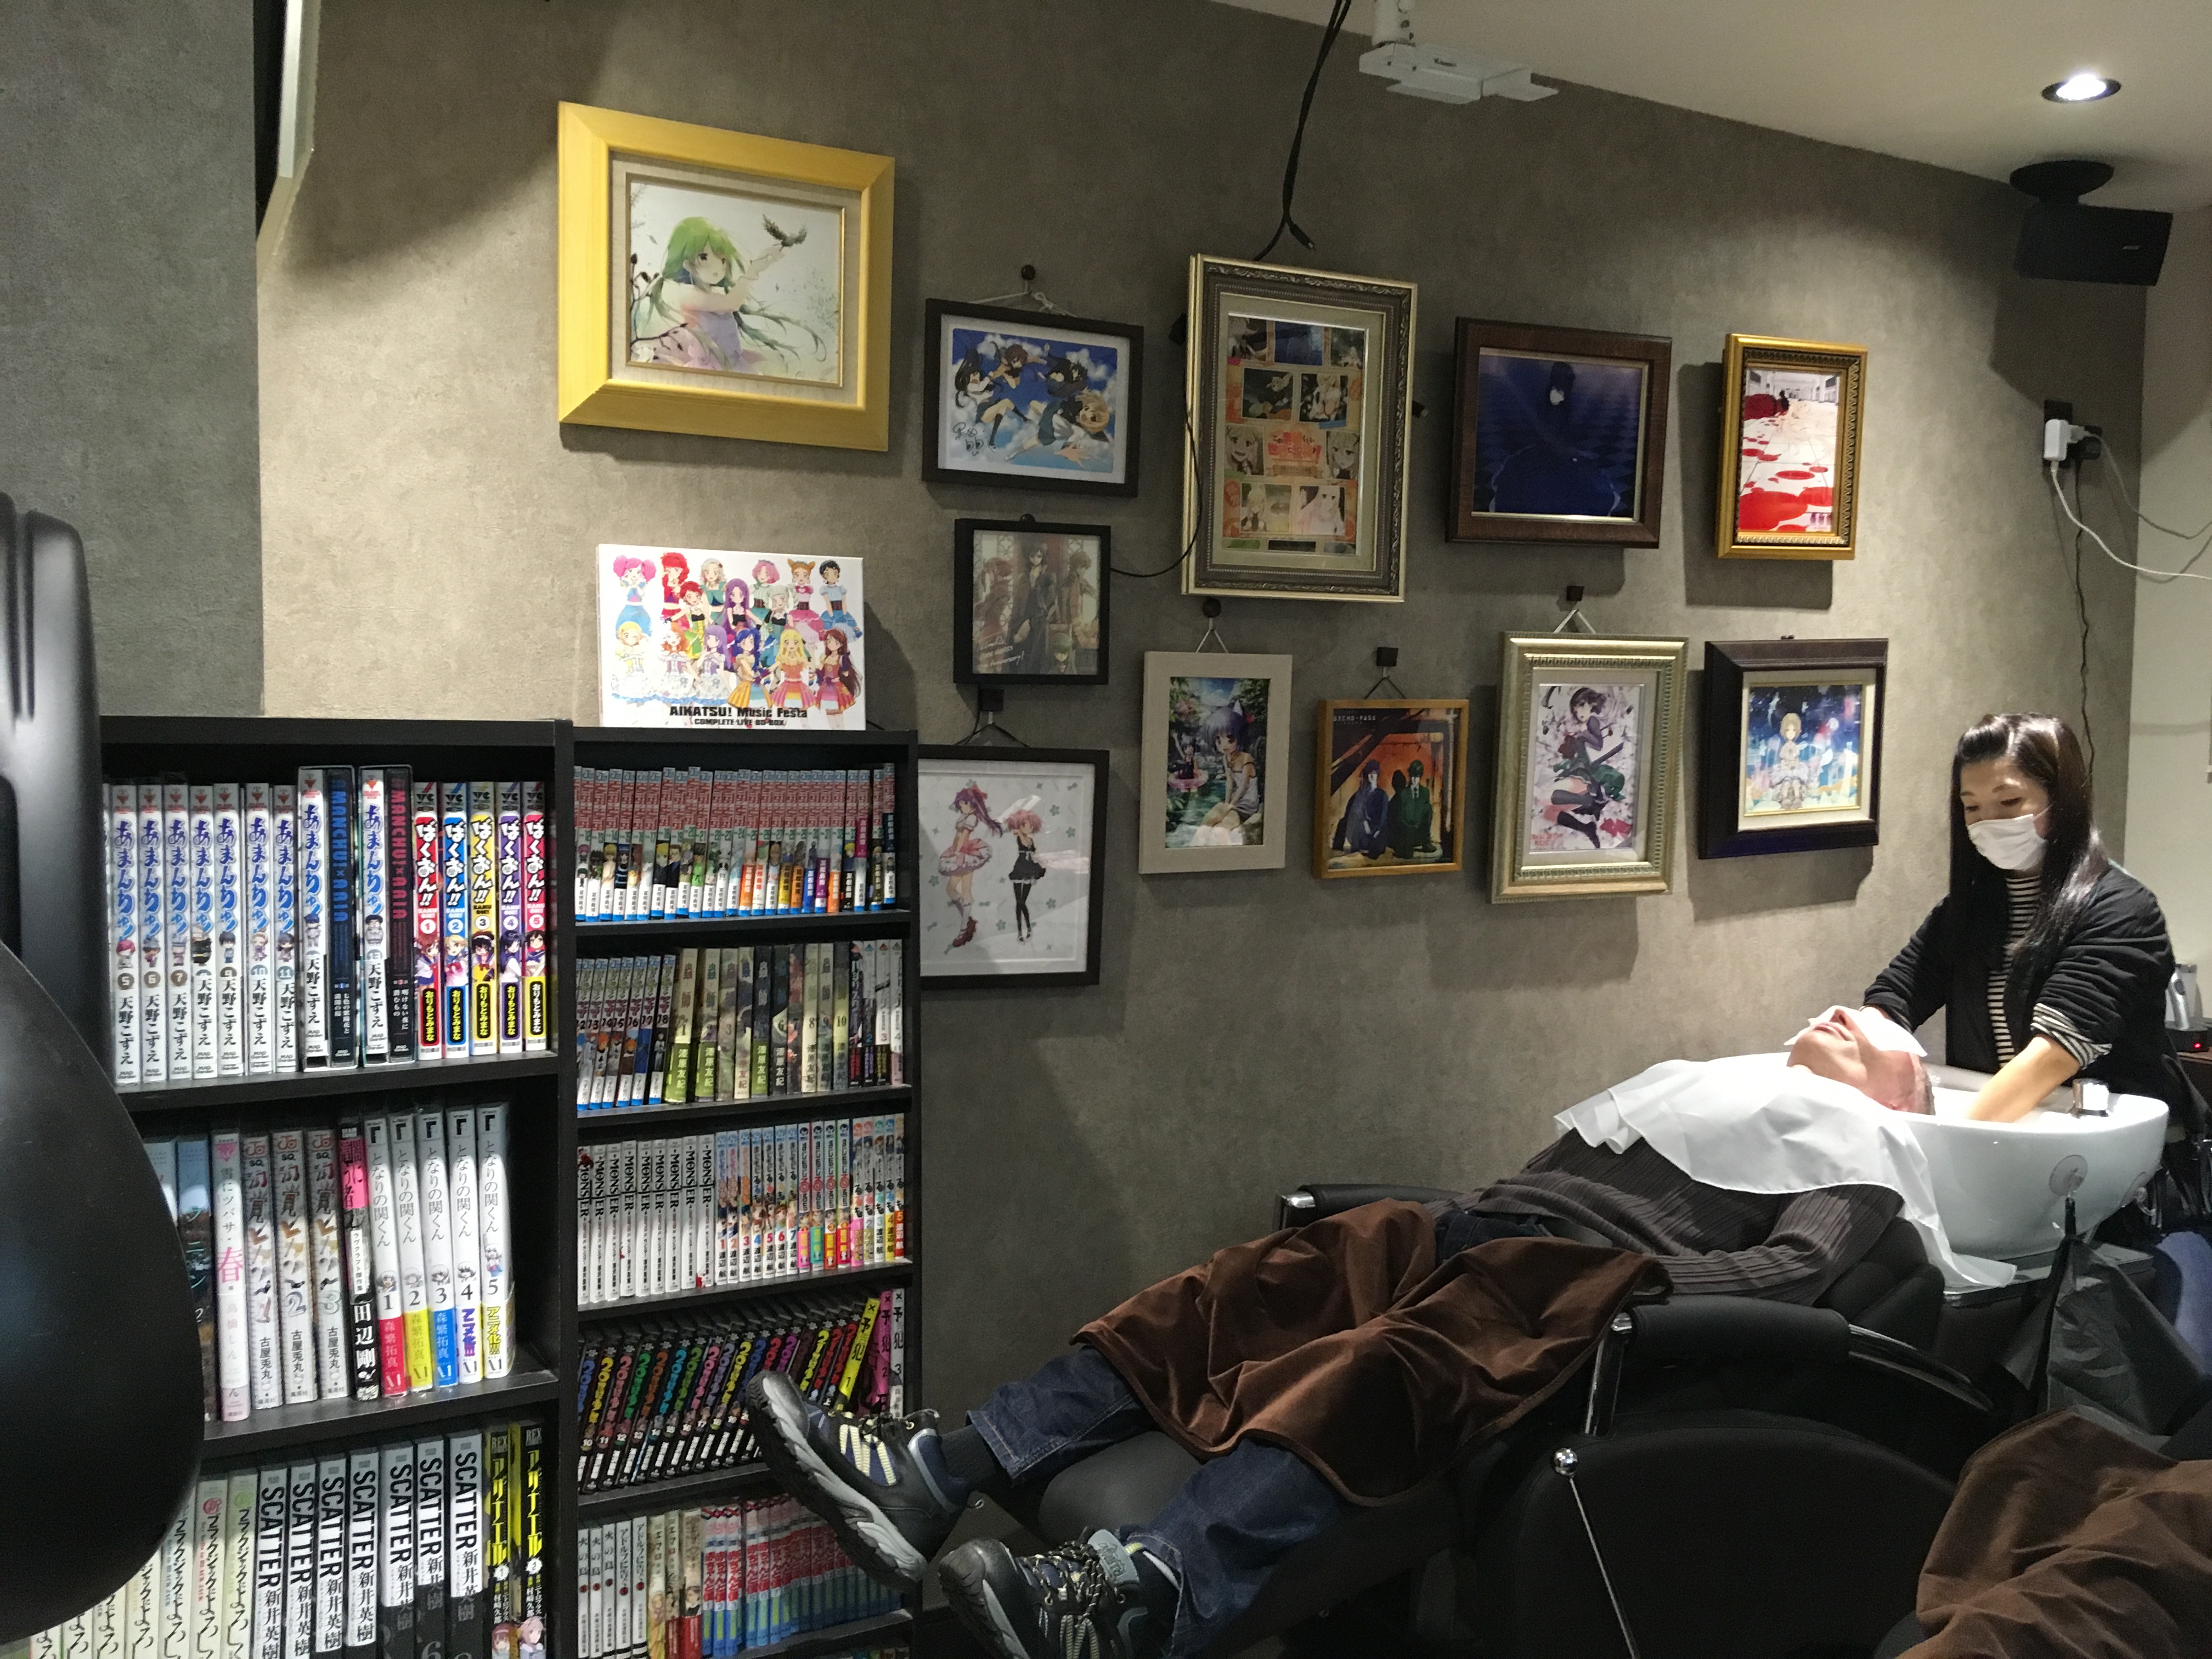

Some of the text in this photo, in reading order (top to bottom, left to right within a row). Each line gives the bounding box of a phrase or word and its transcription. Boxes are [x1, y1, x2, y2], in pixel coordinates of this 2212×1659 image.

[669, 706, 808, 718] AIKATSU! Music Festa
[415, 819, 438, 907] ばくおん!!
[444, 818, 466, 905] ばくおん!!
[472, 817, 494, 904] ばくおん!!
[500, 818, 520, 904] ばくおん!!
[526, 817, 545, 902] ばくおん!!
[196, 979, 212, 1046] 天野こずえ
[222, 979, 238, 1046] 天野こずえ
[252, 978, 268, 1045] 天野こずえ
[279, 983, 296, 1048] 天野こずえ
[306, 958, 320, 1024] 天野こずえ
[368, 963, 384, 1029] 天野こずえ
[425, 990, 435, 1041] おりもとみまな
[452, 989, 461, 1041] おりもとみまな
[479, 985, 488, 1036] おりもとみまな
[507, 985, 516, 1036] おりもとみまな
[532, 983, 541, 1033] おりもとみまな
[117, 996, 134, 1064] 天野こずえ
[145, 995, 161, 1063] 天野こずえ
[172, 992, 188, 1060] 天野こずえ
[588, 1019, 599, 1030] 13
[613, 1018, 625, 1028] 15
[629, 1017, 639, 1026] 16
[641, 1015, 653, 1025] 17
[657, 1014, 668, 1024] 18
[371, 1153, 391, 1248] となりの関くん
[397, 1150, 416, 1244] となりの関くん
[427, 1148, 445, 1241] となりの関くん
[456, 1144, 472, 1238] となりの関くん
[483, 1140, 499, 1233] となりの関くん
[579, 1164, 590, 1217] MONSTER
[594, 1159, 605, 1216] MONSTER
[608, 1157, 620, 1215] MONSTER
[623, 1155, 635, 1212] MONSTER
[640, 1156, 651, 1211] MONSTER
[654, 1154, 665, 1210] MONSTER
[669, 1153, 681, 1209] MONSTER
[685, 1149, 696, 1204] MONSTER
[702, 1149, 713, 1204] MONSTER
[720, 1239, 725, 1249] 1
[730, 1239, 738, 1249] 2
[743, 1235, 751, 1246] 3
[753, 1234, 761, 1244] 4
[766, 1233, 773, 1243] 5
[778, 1232, 785, 1242] 6
[256, 1297, 272, 1323] 1
[285, 1291, 307, 1317] 2
[318, 1290, 341, 1314] 3
[385, 1295, 393, 1310] 1
[408, 1290, 421, 1306] 2
[435, 1287, 448, 1304] 3
[460, 1285, 473, 1301] 4
[487, 1279, 499, 1295] 5
[259, 1336, 272, 1380] 古屋兎丸
[291, 1329, 304, 1372] 古屋兎丸
[327, 1326, 340, 1369] 古屋兎丸
[354, 1304, 376, 1369] 田辺剛
[436, 1312, 449, 1359] 森繁拓真
[846, 1376, 851, 1387] 1
[882, 1367, 888, 1377] 2
[894, 1363, 901, 1375] 3
[319, 1476, 345, 1578] SCATTER
[351, 1470, 376, 1571] SCATTER
[389, 1464, 413, 1565] SCATTER
[419, 1457, 443, 1557] SCATTER
[454, 1452, 477, 1550] SCATTER
[257, 1486, 285, 1589] SCATTER
[289, 1483, 315, 1584] SCATTER
[324, 1577, 343, 1649] 新井英樹
[356, 1570, 375, 1642] 新井英樹
